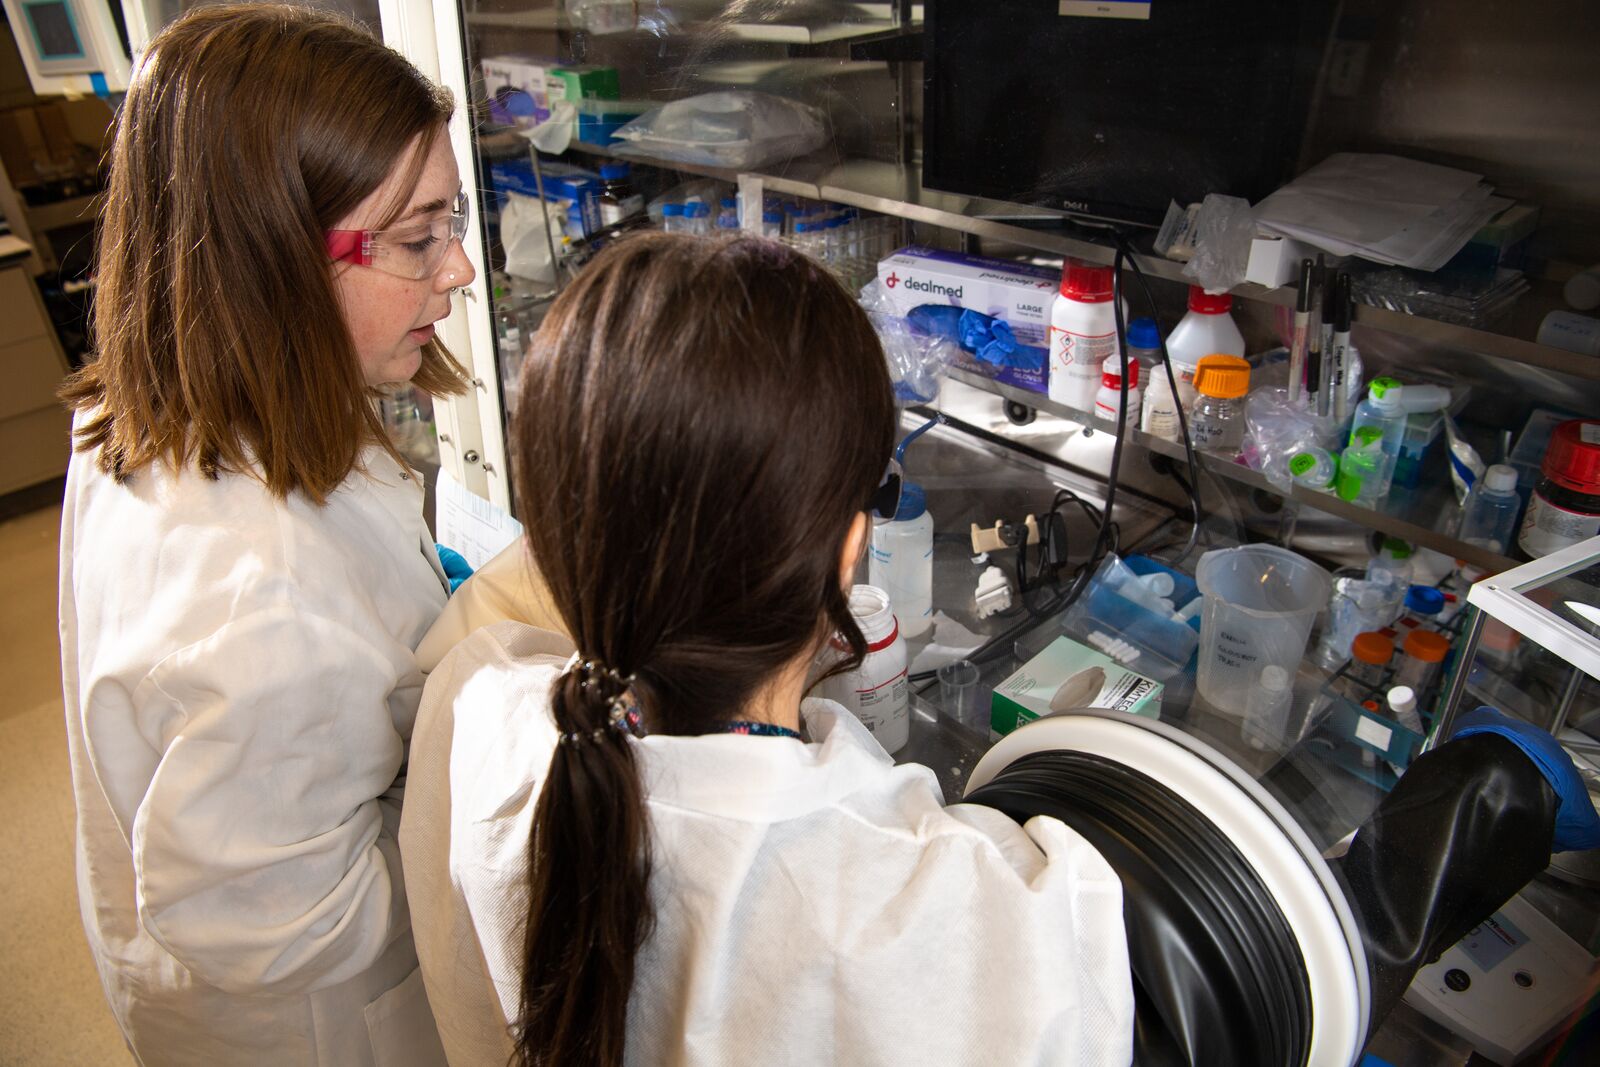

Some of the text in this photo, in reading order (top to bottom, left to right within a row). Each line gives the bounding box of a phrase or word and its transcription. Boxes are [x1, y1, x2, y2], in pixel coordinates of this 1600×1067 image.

[979, 271, 1034, 286] dealmed
[904, 277, 963, 298] dealmed
[1016, 303, 1043, 314] LARGE
[1013, 371, 1043, 384] GLOVES
